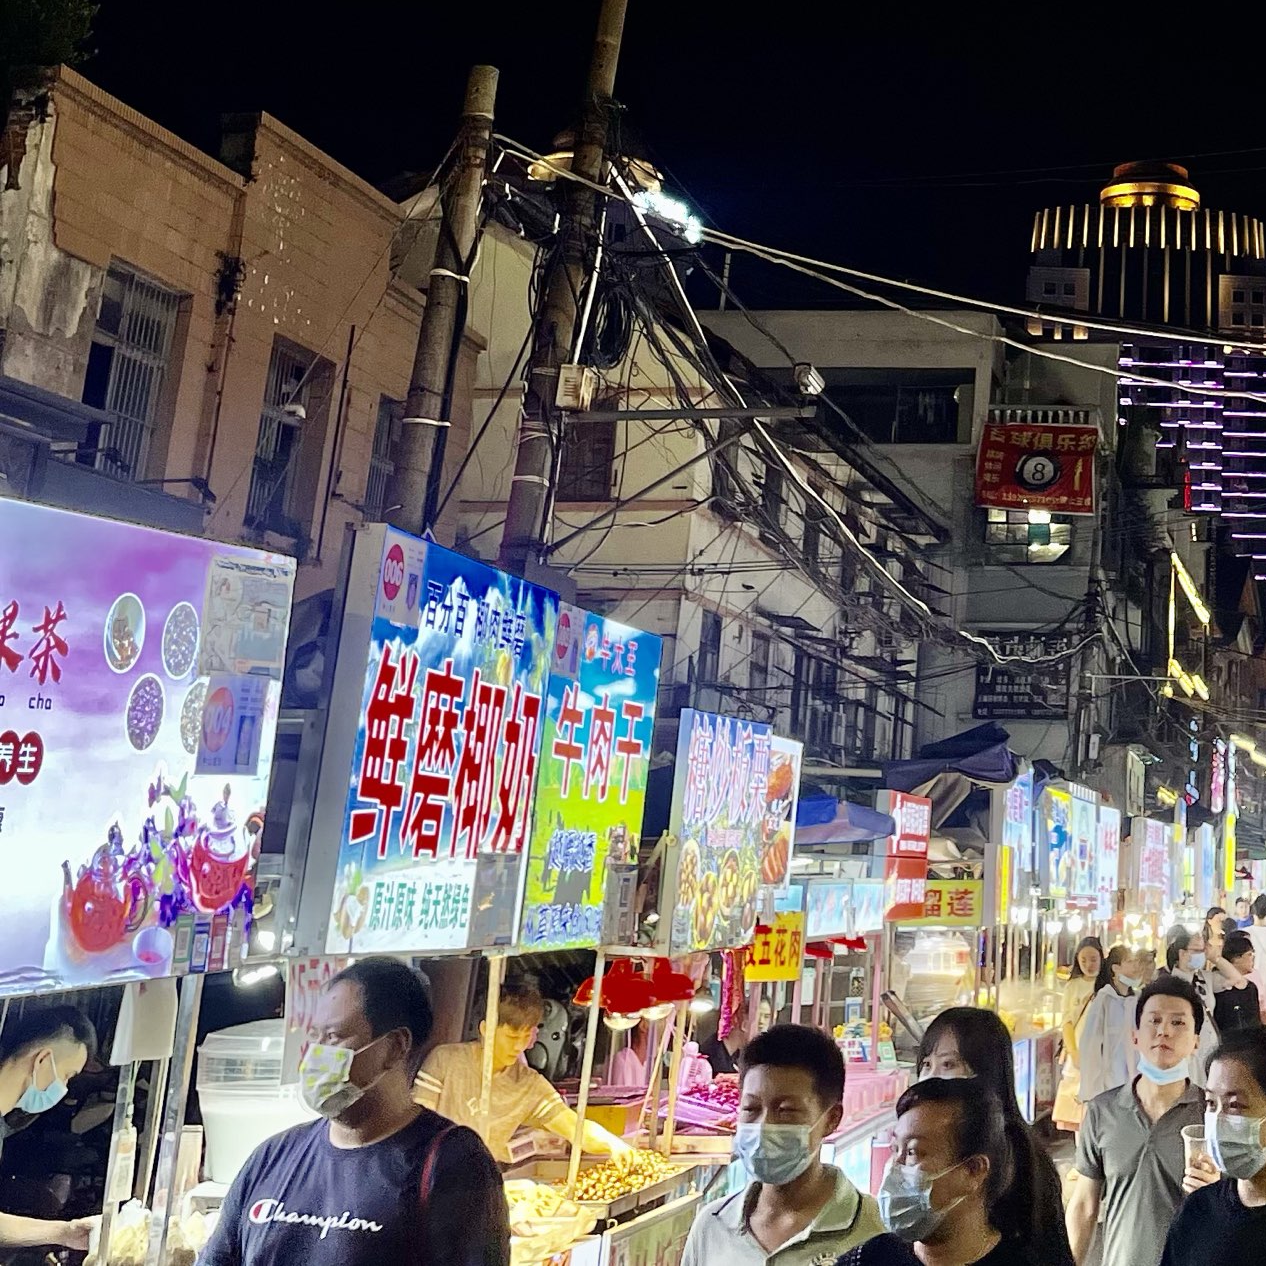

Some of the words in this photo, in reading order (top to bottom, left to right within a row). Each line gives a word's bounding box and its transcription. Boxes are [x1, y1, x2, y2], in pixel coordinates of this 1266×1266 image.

[990, 428, 1097, 451] 台球俱乐部
[385, 558, 404, 586] 006
[426, 579, 470, 638] 百分百
[28, 692, 52, 710] cha
[349, 640, 542, 861] 鲜磨椰奶
[552, 683, 644, 805] 牛肉干
[683, 714, 771, 826] 糖炒板栗
[368, 882, 416, 929] 原汁原味
[419, 882, 470, 929] 纯天然绿色
[249, 1199, 383, 1239] Champion
